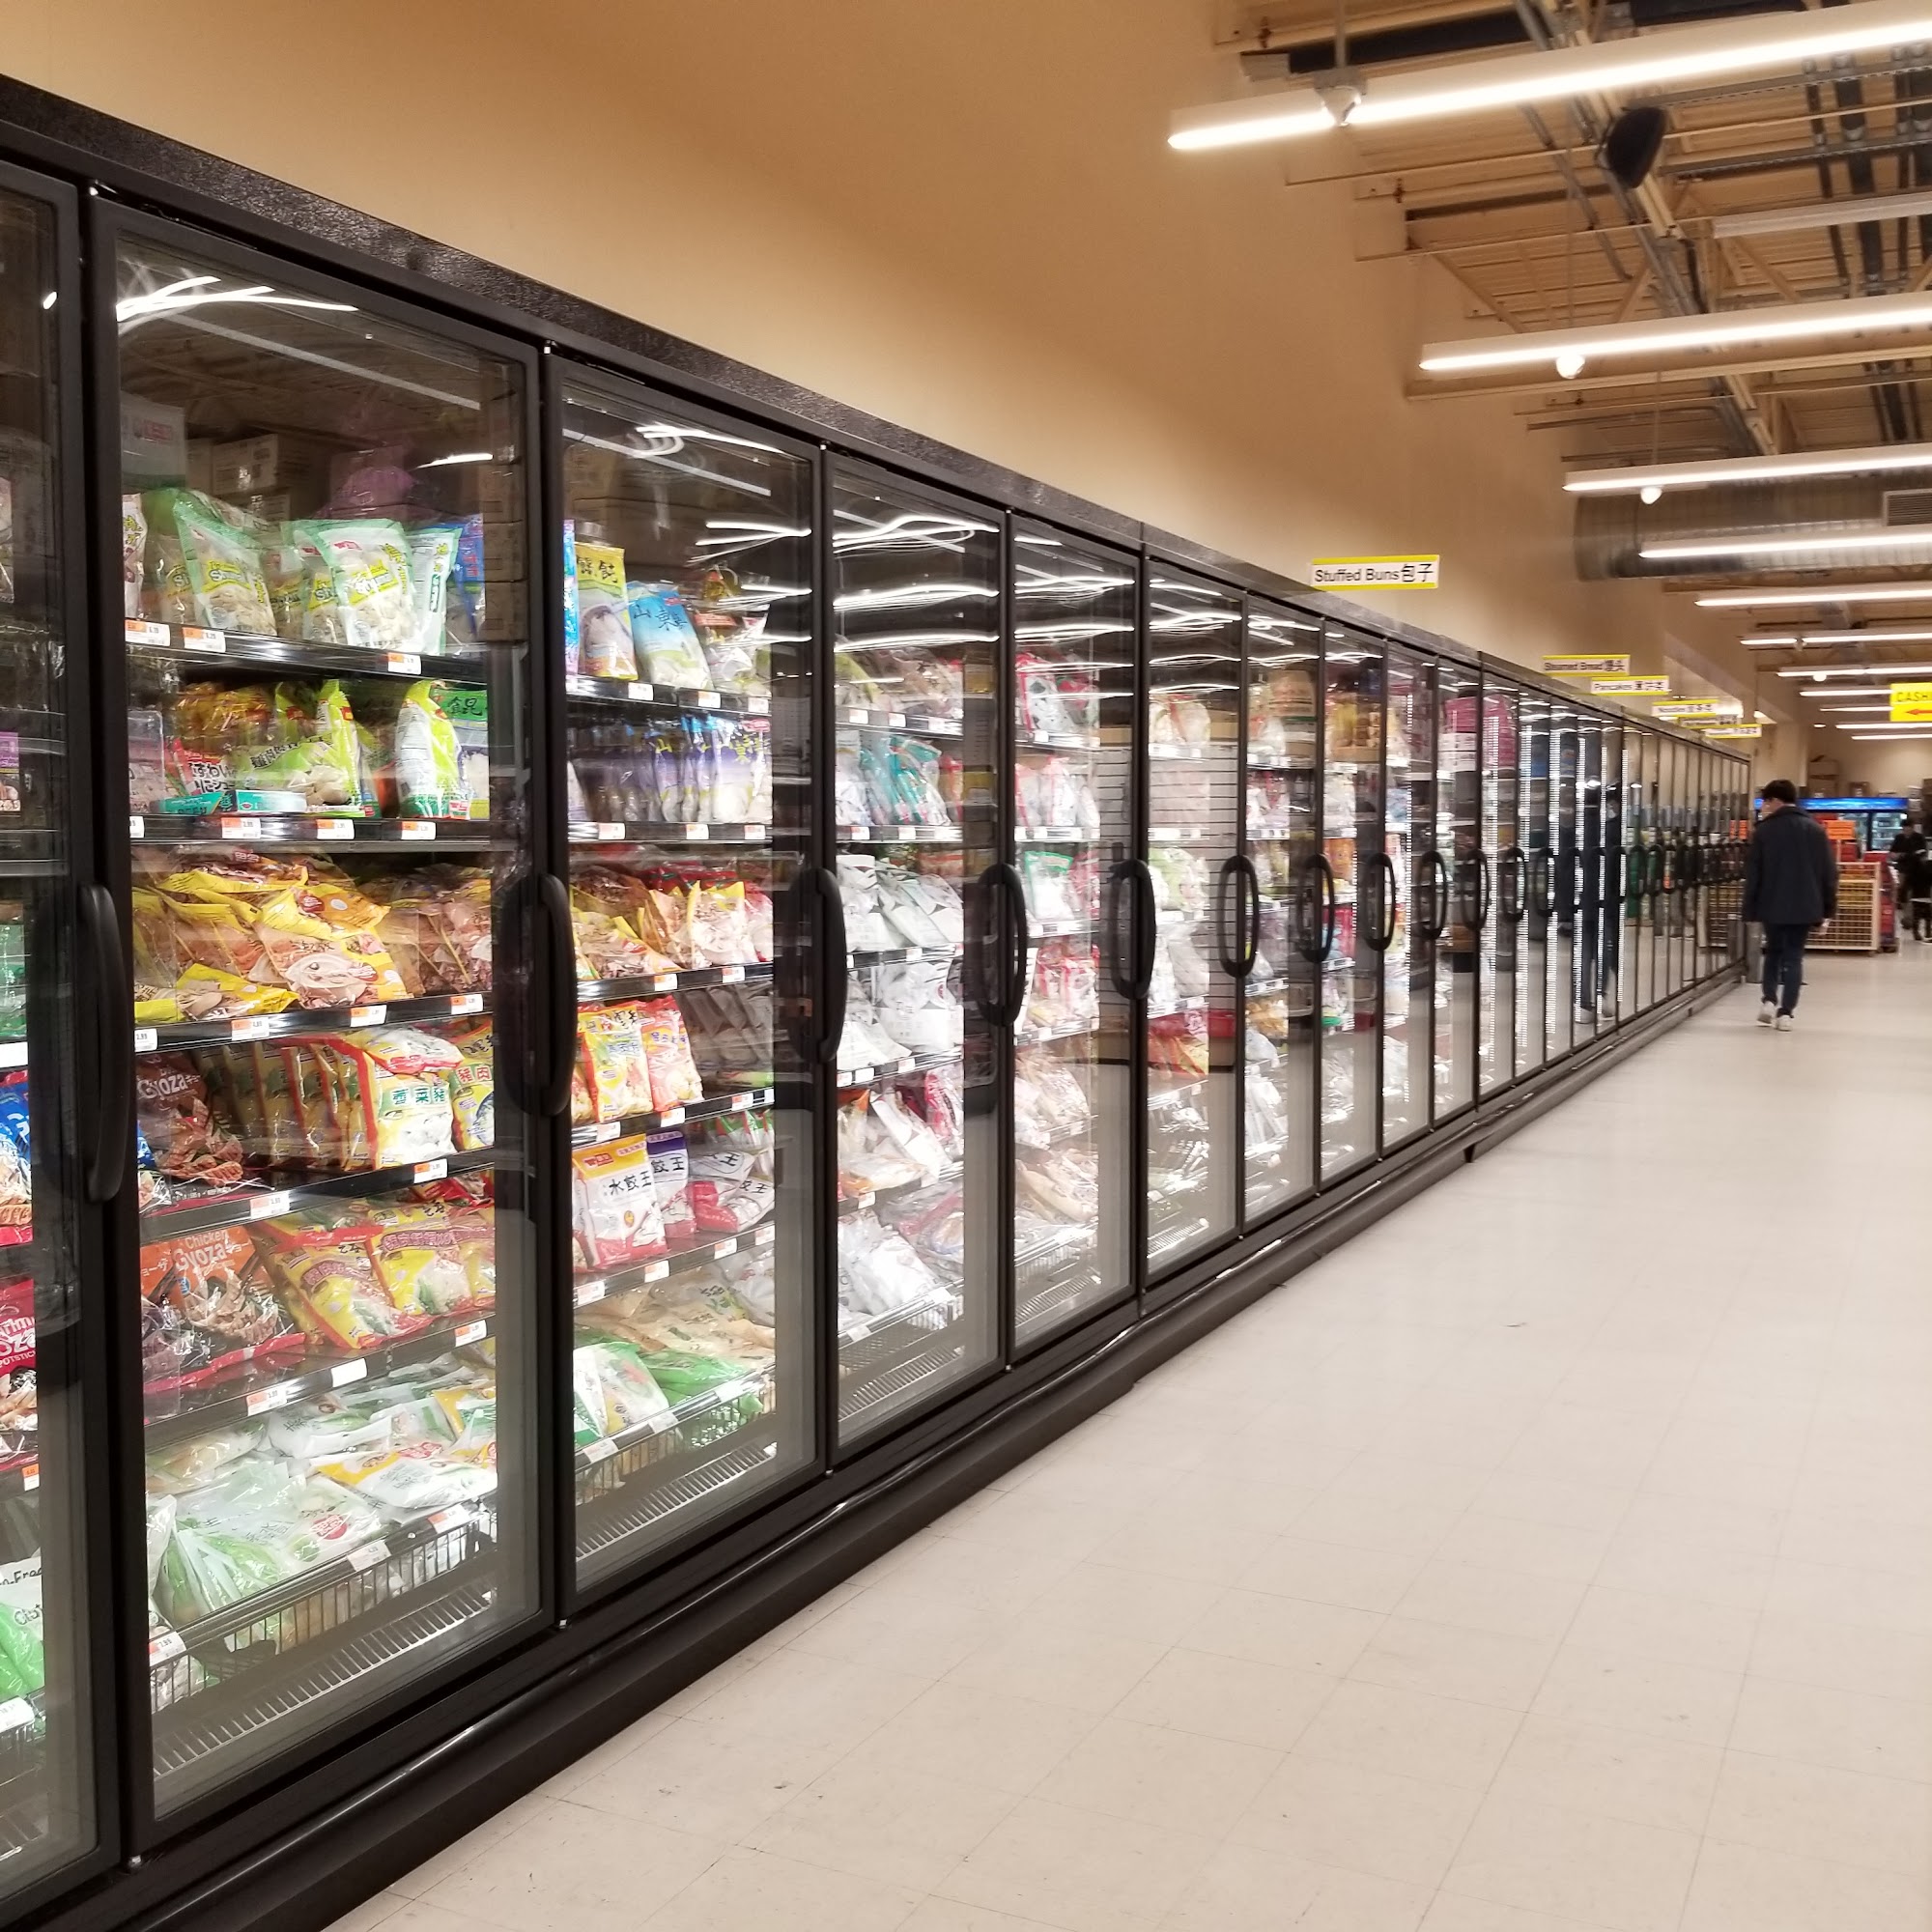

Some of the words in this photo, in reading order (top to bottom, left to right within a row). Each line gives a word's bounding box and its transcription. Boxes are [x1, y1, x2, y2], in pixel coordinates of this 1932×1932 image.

[1315, 569, 1361, 582] Stuffed
[1366, 568, 1399, 582] Buns
[1401, 563, 1434, 582] 包子
[1579, 662, 1603, 670] Bread
[137, 1072, 188, 1101] Gyoza
[185, 1229, 229, 1249] Chicken
[173, 1242, 227, 1272] Gyoza
